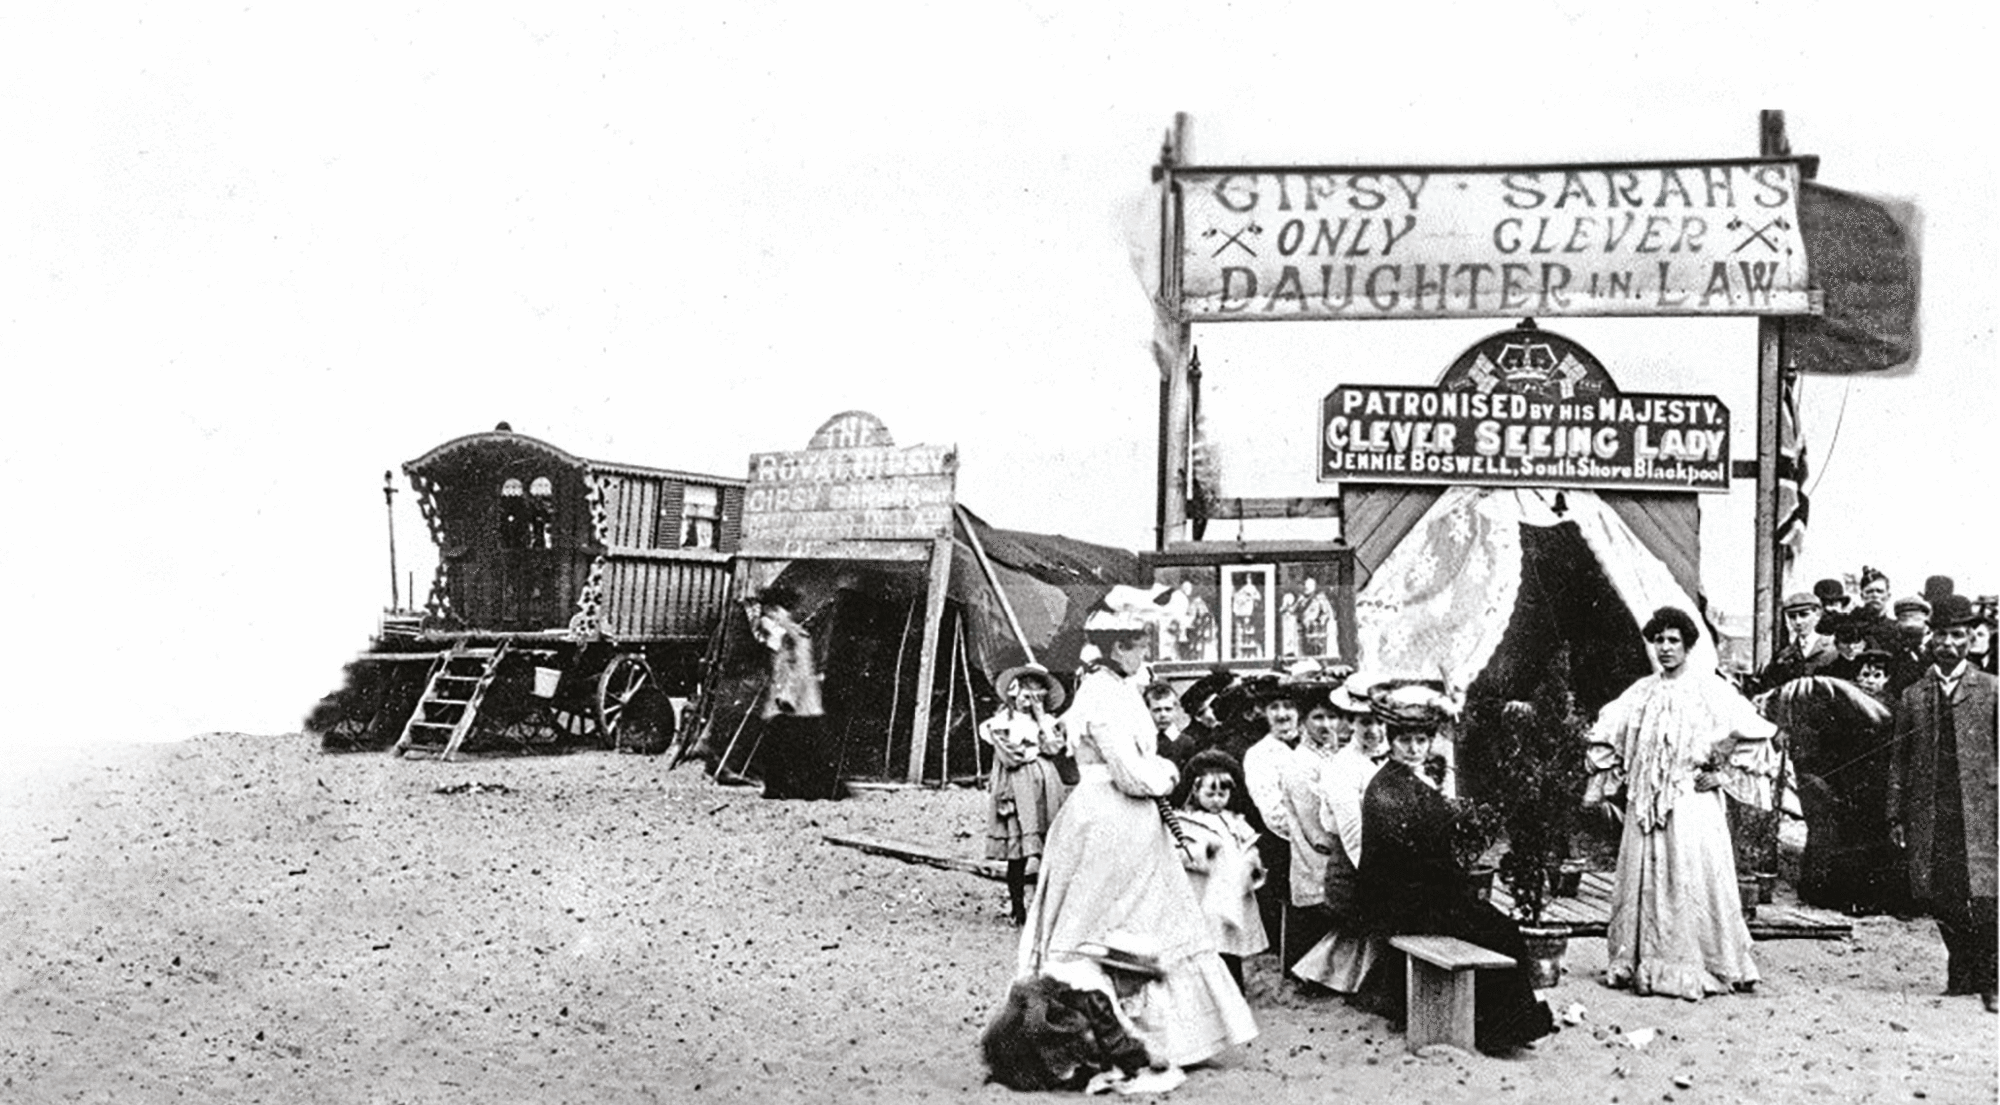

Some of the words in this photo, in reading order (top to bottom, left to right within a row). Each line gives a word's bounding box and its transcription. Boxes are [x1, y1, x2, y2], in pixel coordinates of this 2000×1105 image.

[1277, 214, 1416, 256] ONLY
[1217, 260, 1572, 313] DAUGHTER
[1656, 260, 1780, 307] LAW
[1343, 390, 1527, 420] PATRONISED
[1529, 403, 1554, 420] BY
[1559, 404, 1595, 421] HIS
[1599, 397, 1724, 425] MAJESTY.
[1326, 416, 1457, 454] CLEVER
[1474, 420, 1620, 459] SEEING
[1633, 424, 1726, 461] LADY
[1328, 450, 1406, 471] JENNIE
[1410, 451, 1520, 477] BOSWELL,
[1520, 454, 1576, 477] South
[1577, 455, 1633, 478] Shore
[1634, 457, 1725, 486] Blackpool
